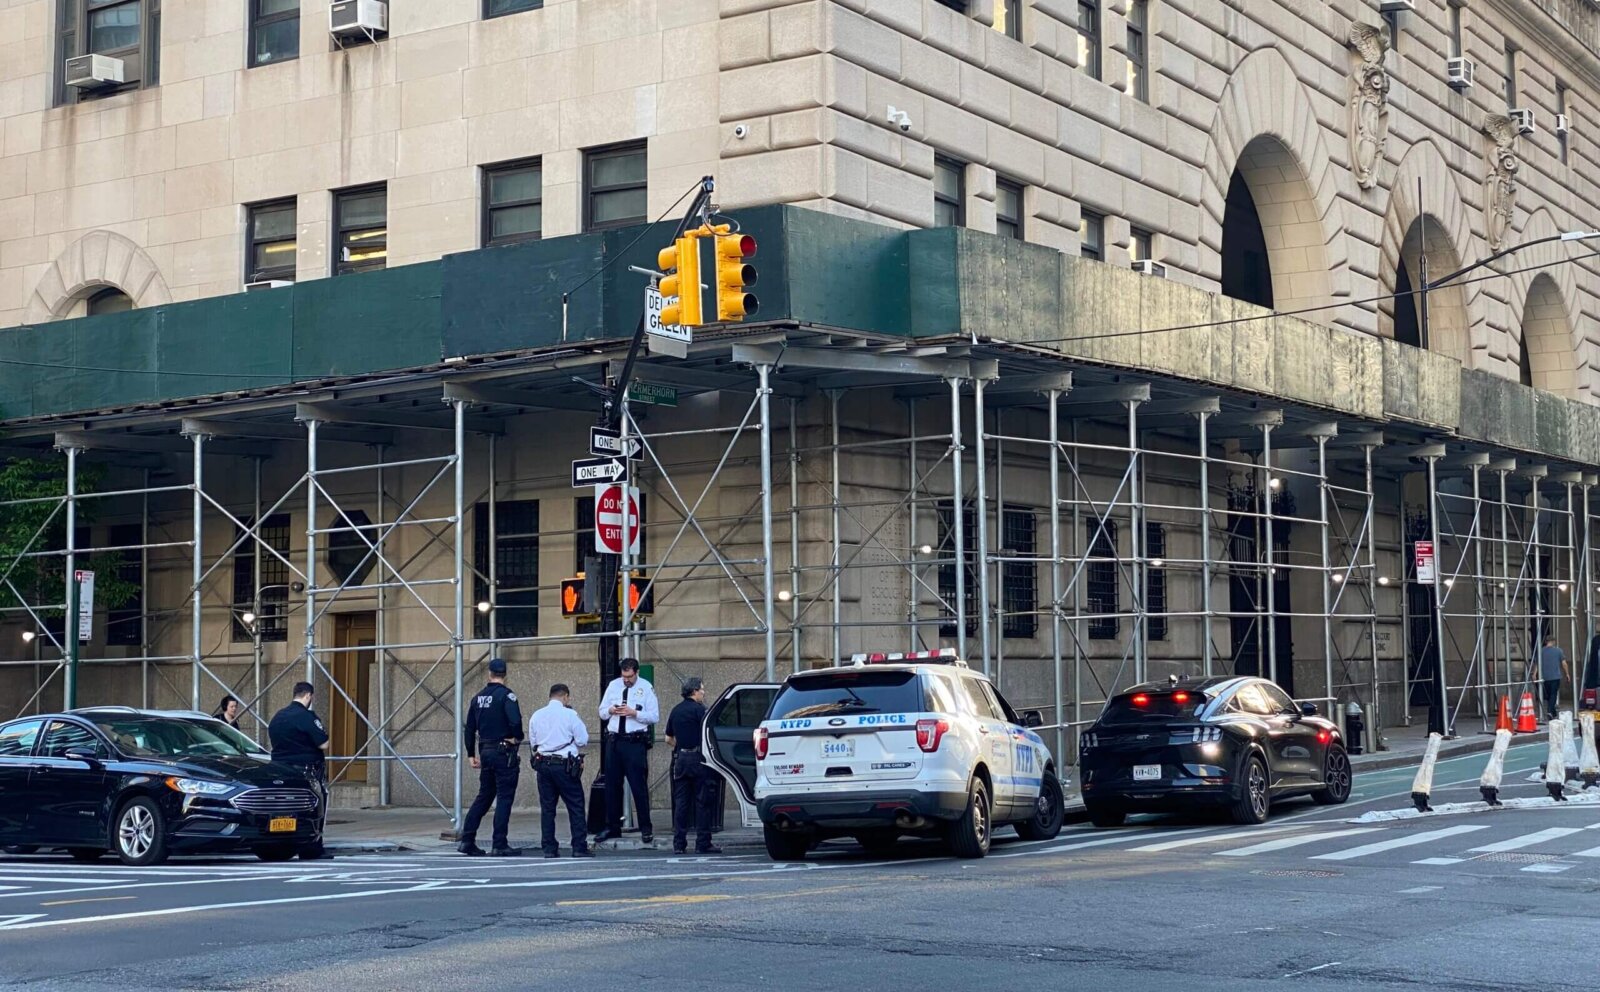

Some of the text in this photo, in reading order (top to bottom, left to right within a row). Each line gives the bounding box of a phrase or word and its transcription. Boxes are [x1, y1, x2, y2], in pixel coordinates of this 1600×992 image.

[598, 436, 614, 449] ONE
[580, 464, 620, 479] ONE WAY
[603, 498, 615, 509] DO
[780, 714, 906, 730] NYPD POLICE
[824, 743, 846, 754] 5440
